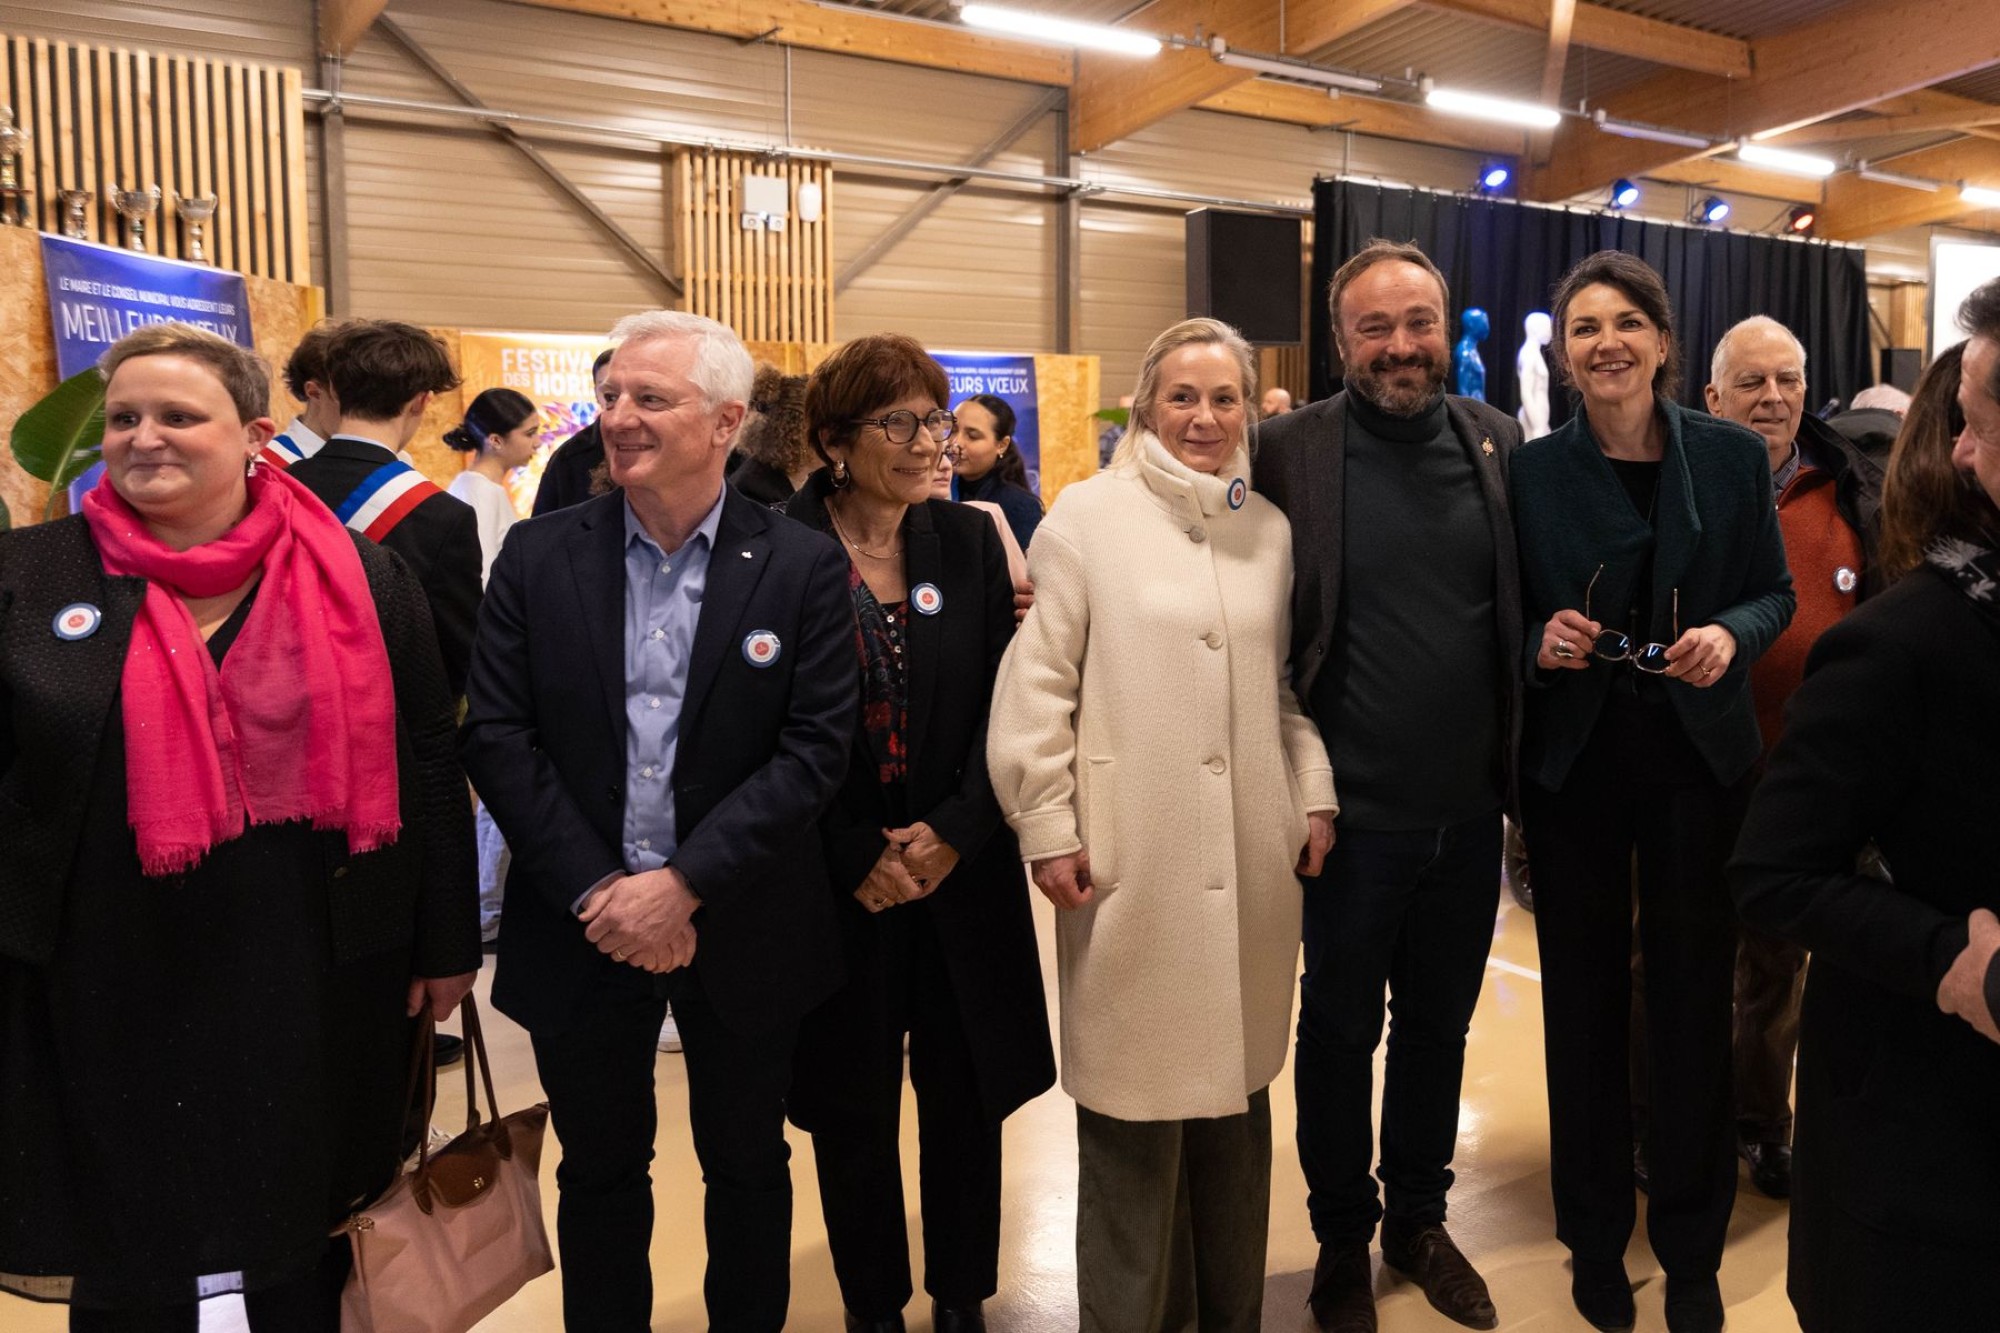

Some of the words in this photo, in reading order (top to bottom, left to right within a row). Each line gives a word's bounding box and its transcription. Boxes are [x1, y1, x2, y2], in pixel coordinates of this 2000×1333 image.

[60, 277, 70, 290] LE
[61, 302, 177, 343] MEILLE
[501, 349, 592, 374] FESTIVA
[502, 373, 531, 387] DES
[949, 376, 984, 394] EURS
[986, 377, 1029, 394] VŒUX
